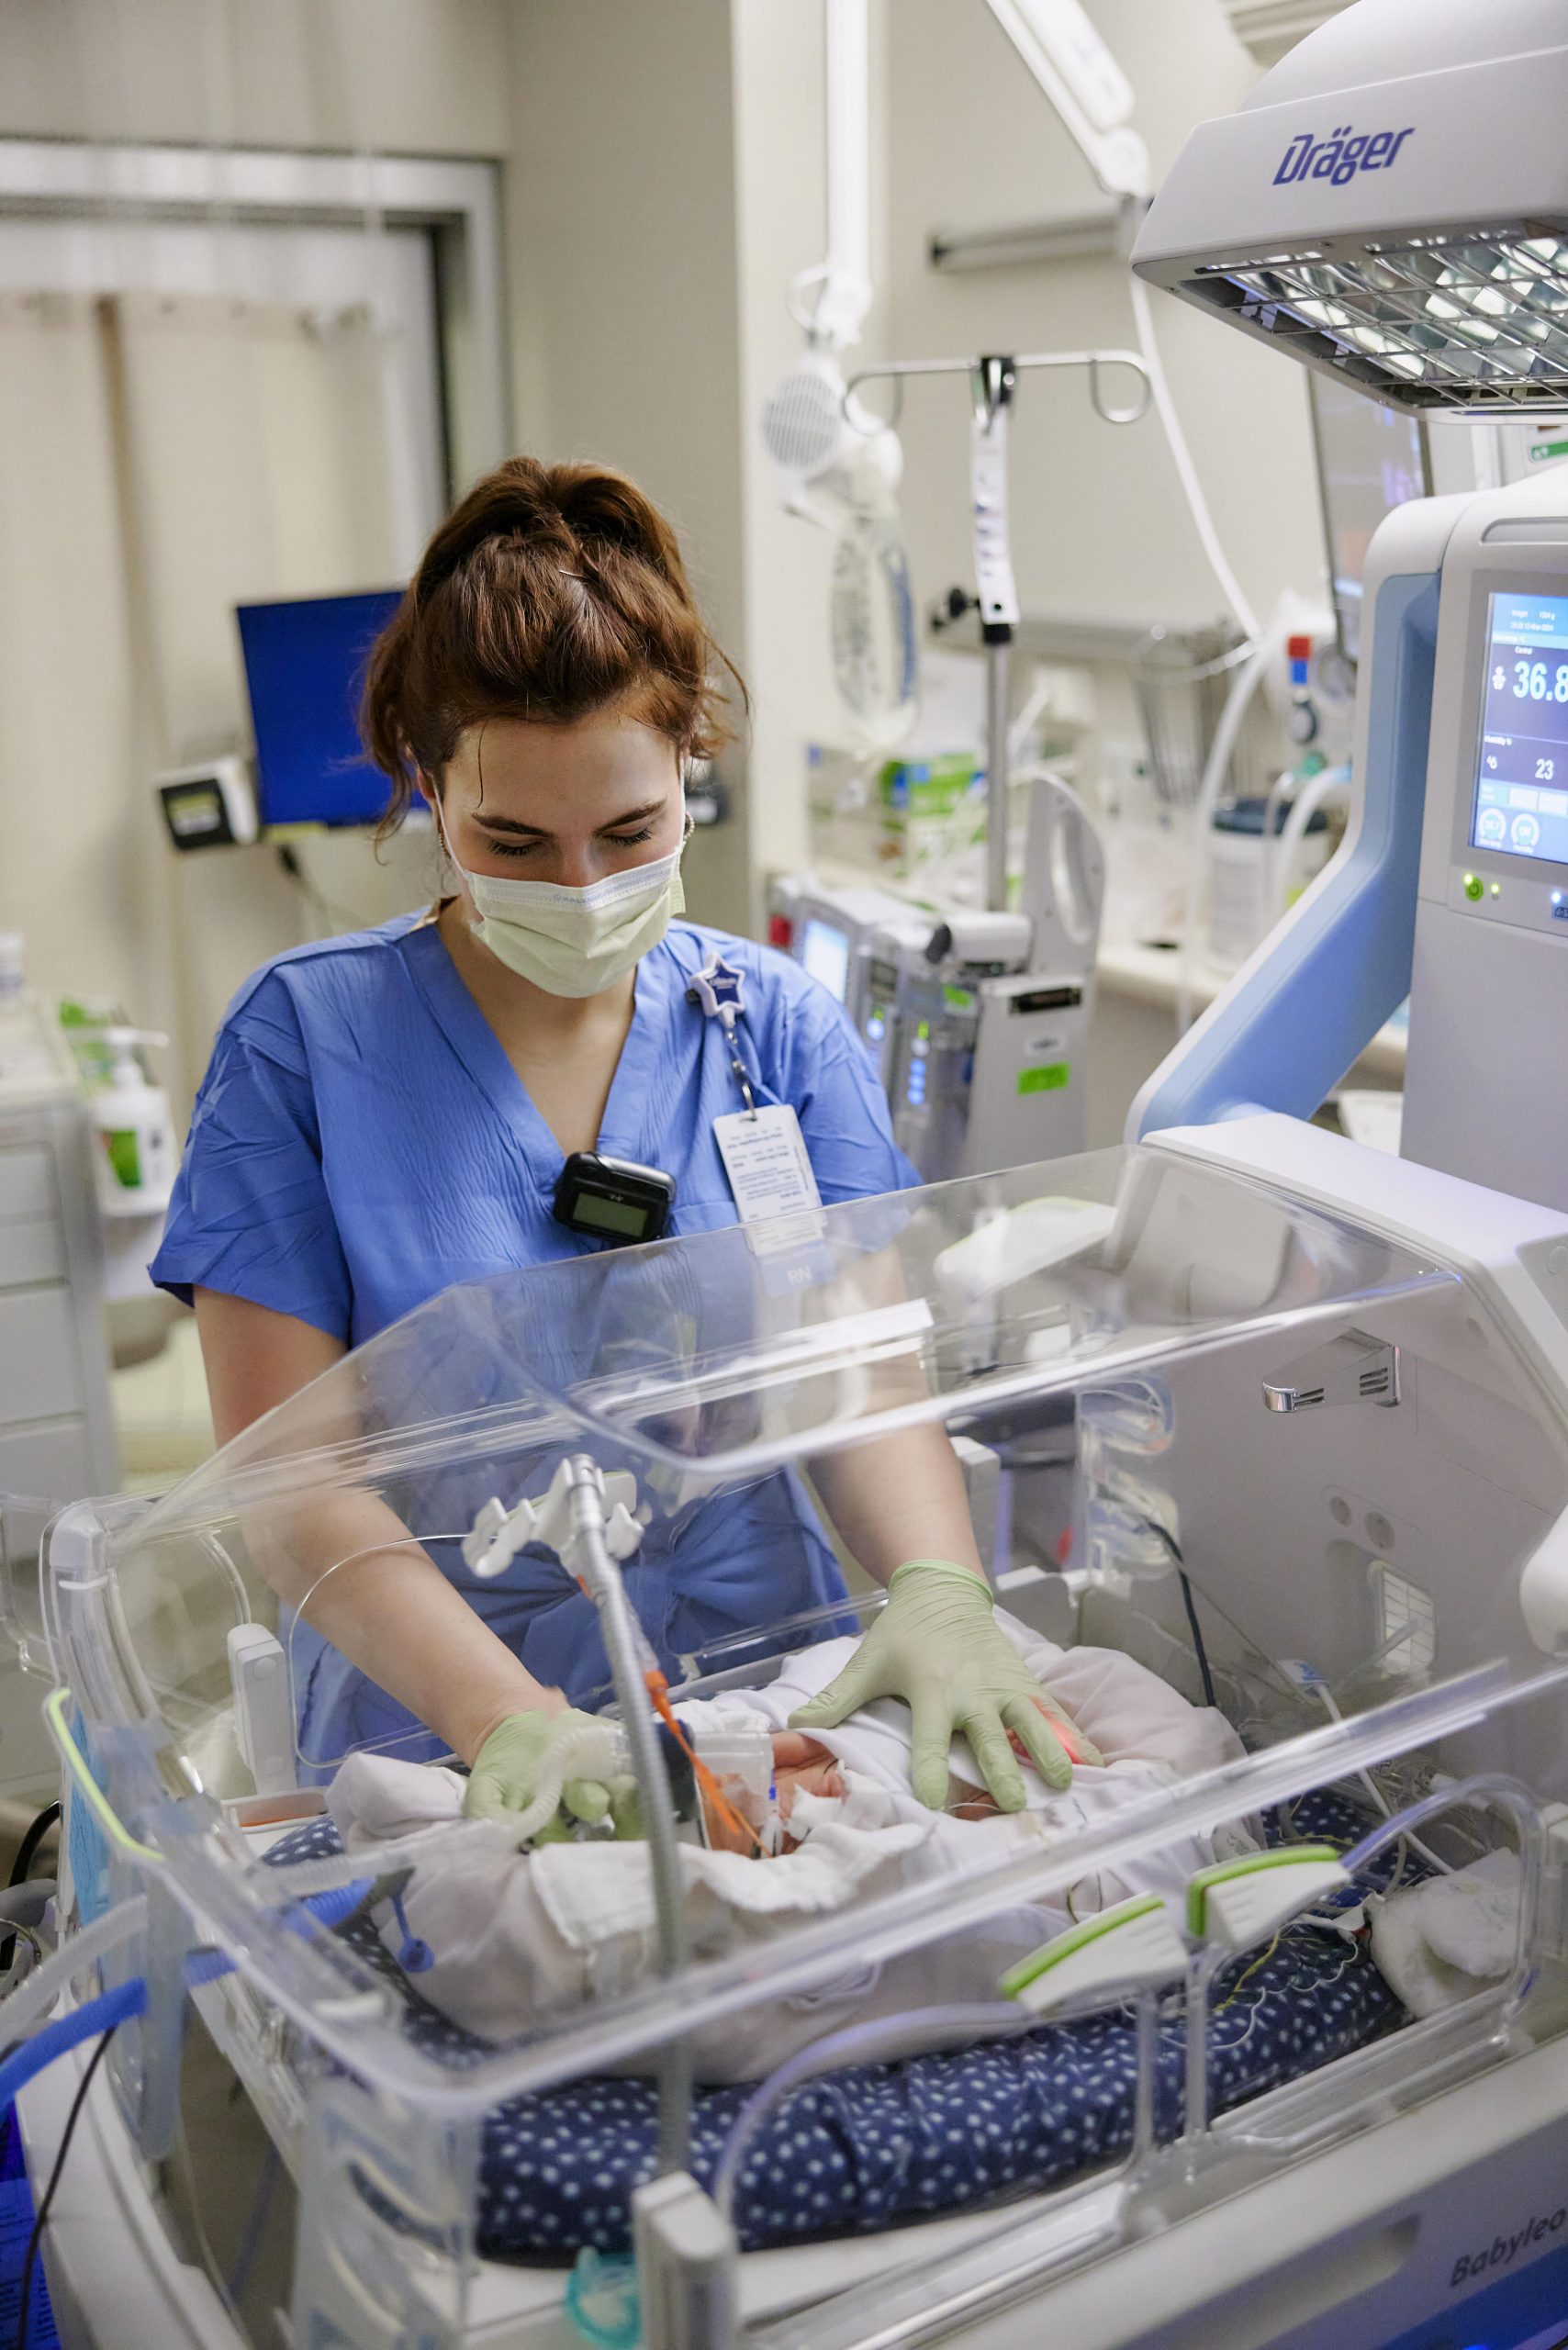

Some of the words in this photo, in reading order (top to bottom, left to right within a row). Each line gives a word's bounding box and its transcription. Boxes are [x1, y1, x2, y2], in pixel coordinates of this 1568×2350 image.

[1271, 125, 1416, 186] Dräger
[1512, 660, 1568, 703] 36.8
[1534, 758, 1554, 780] 23
[1450, 2208, 1567, 2287] Babyleo
